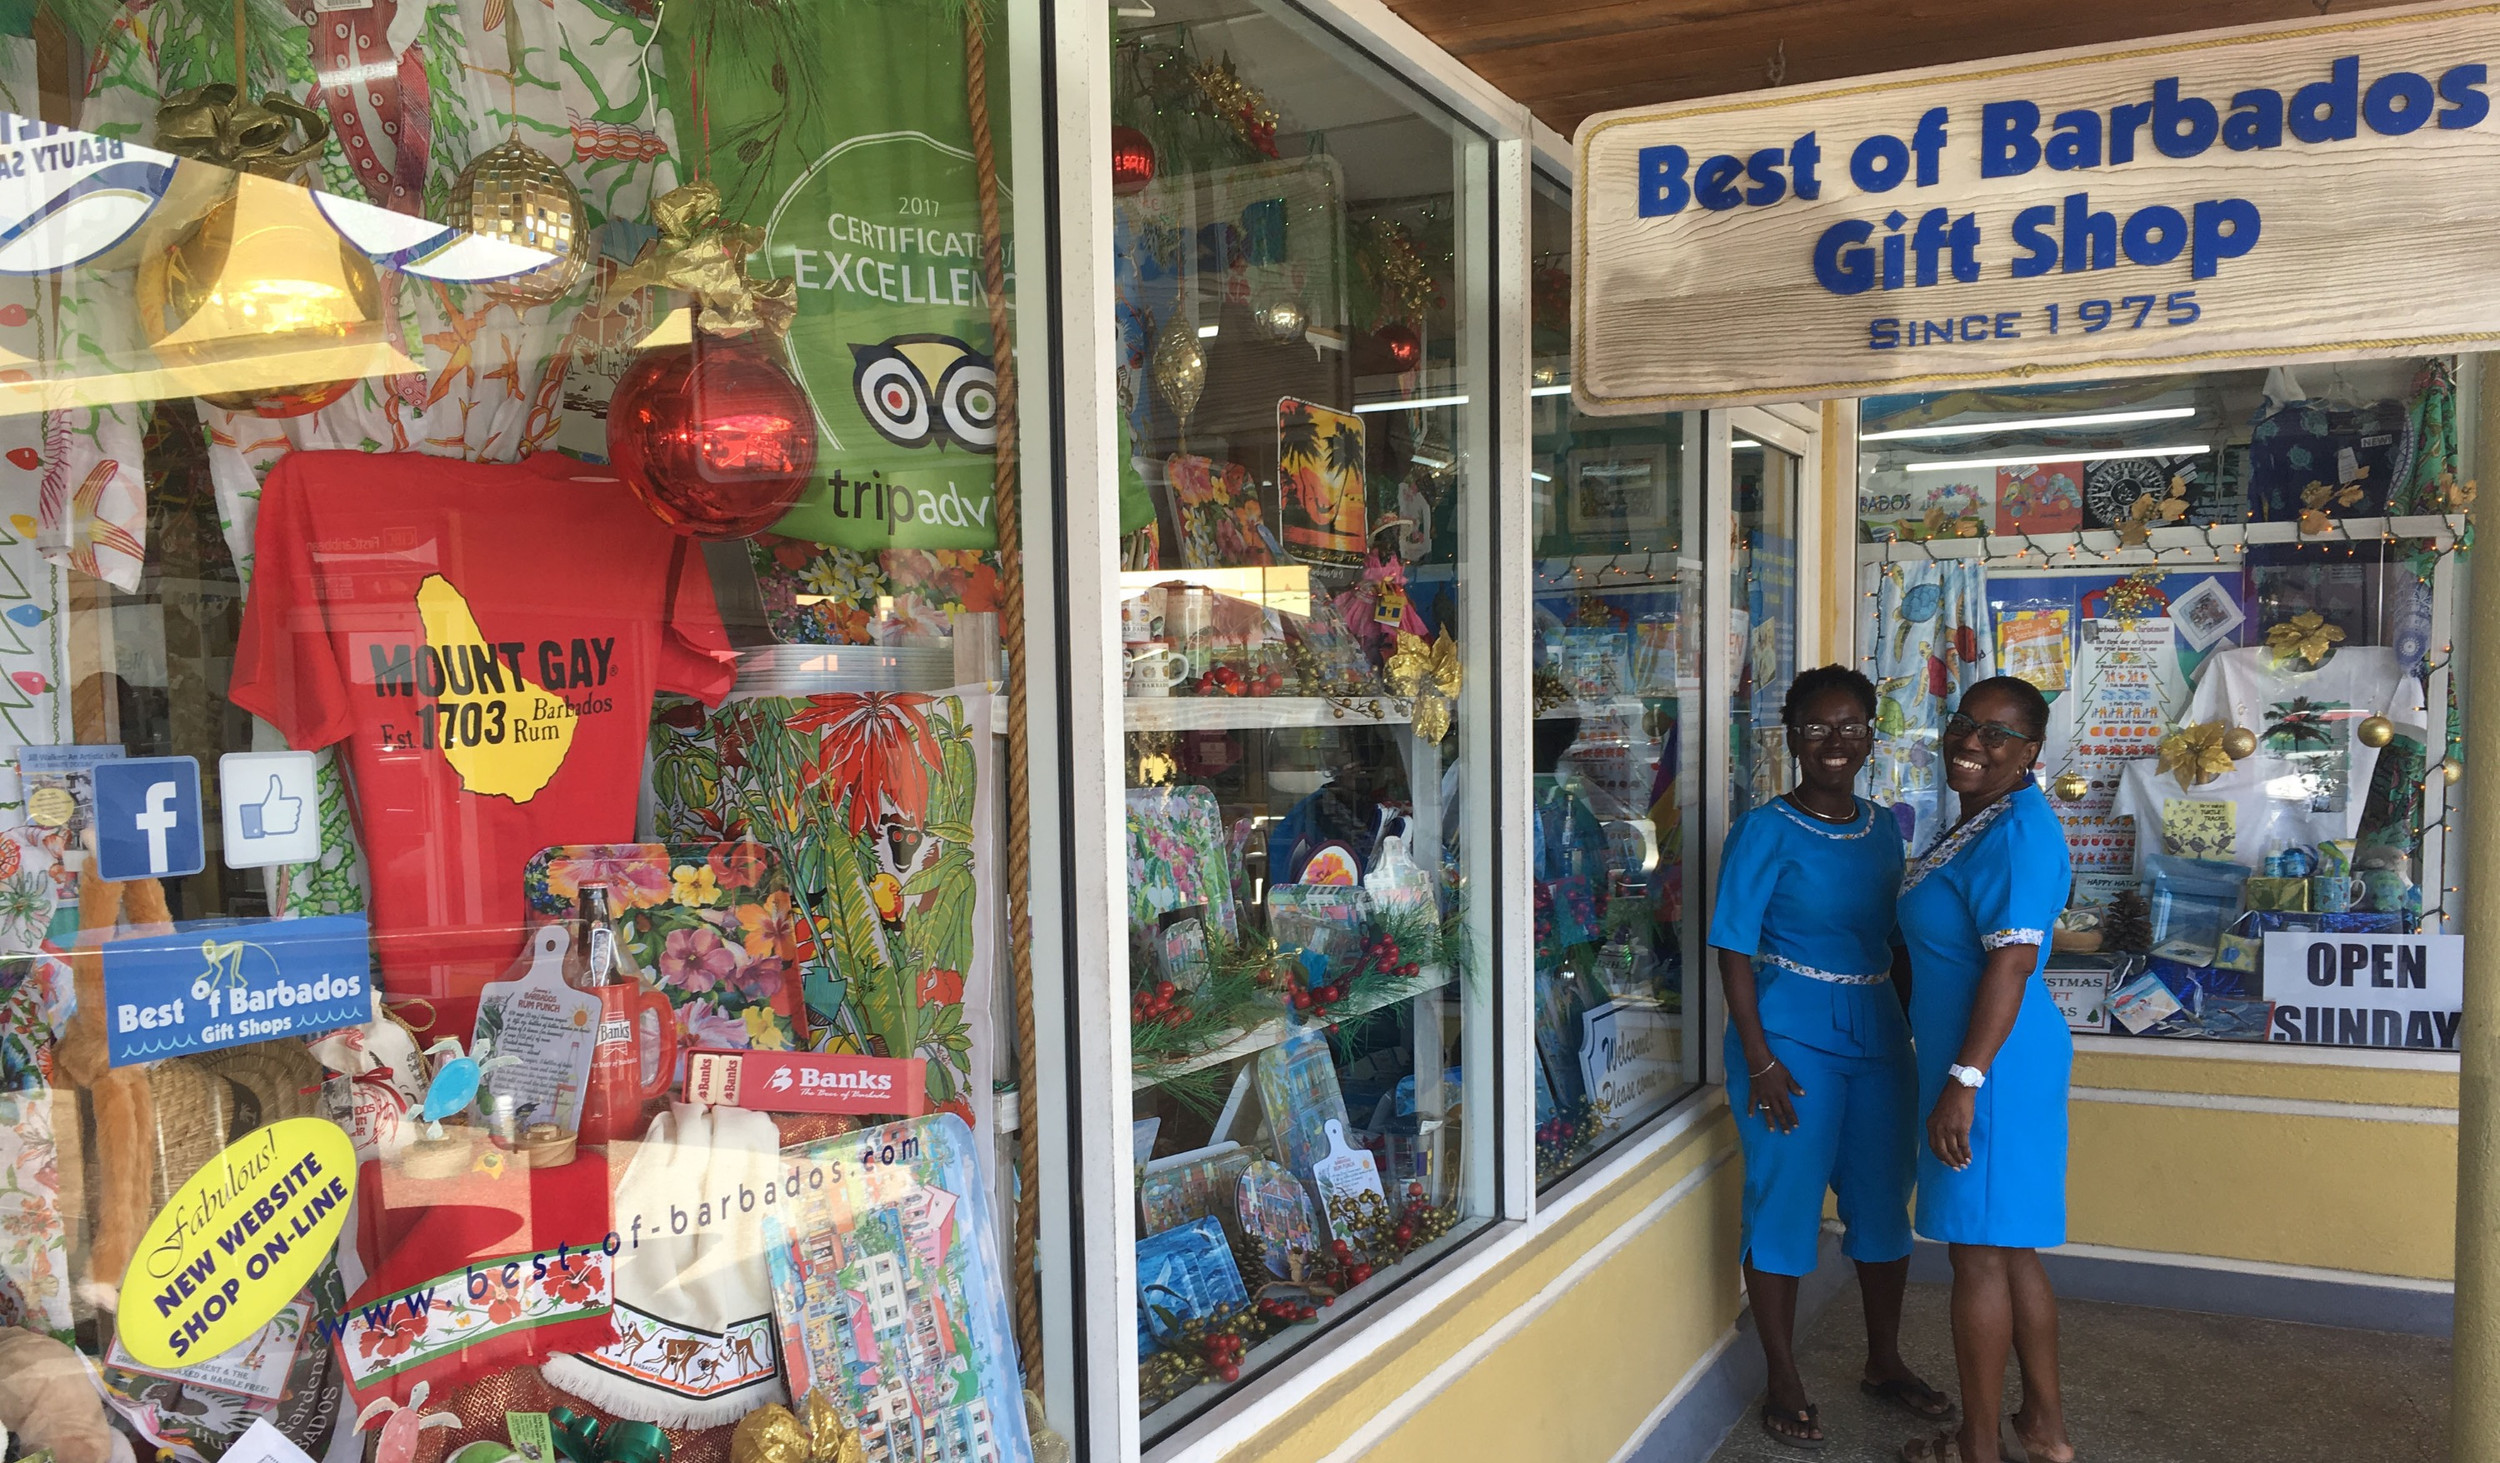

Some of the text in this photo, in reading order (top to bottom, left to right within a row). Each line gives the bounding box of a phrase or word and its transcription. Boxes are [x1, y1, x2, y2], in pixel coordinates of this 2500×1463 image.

[1637, 55, 2491, 219] Best of Barbados
[898, 197, 940, 217] 2017
[1813, 193, 2261, 297] Gift Shop
[1868, 290, 2203, 351] SINCE 1975
[828, 469, 997, 535] tripadv
[370, 637, 616, 697] MOUNT GAY
[416, 700, 506, 750] 1703
[513, 718, 560, 743] Rum
[533, 692, 613, 721] Barbados
[2307, 942, 2427, 989] OPEN
[118, 973, 362, 1034] Best of Barbados
[518, 999, 560, 1013] RUM PUNCH
[201, 1016, 292, 1043] Gift Shops
[600, 1023, 630, 1042] Banks
[2274, 1005, 2463, 1049] SUNDAY
[700, 1058, 712, 1091] Banks
[725, 1060, 738, 1092] Banks
[799, 1067, 892, 1091] Banks
[840, 1090, 850, 1101] of
[147, 1128, 279, 1279] Fabulous!
[153, 1151, 323, 1319] NEW WEBSITE
[169, 1176, 349, 1359] SHOP ON-LINE
[211, 1375, 243, 1388] HASSLE
[244, 1382, 270, 1394] FREE!
[233, 1370, 249, 1380] THE
[277, 1348, 328, 1435] Gardens
